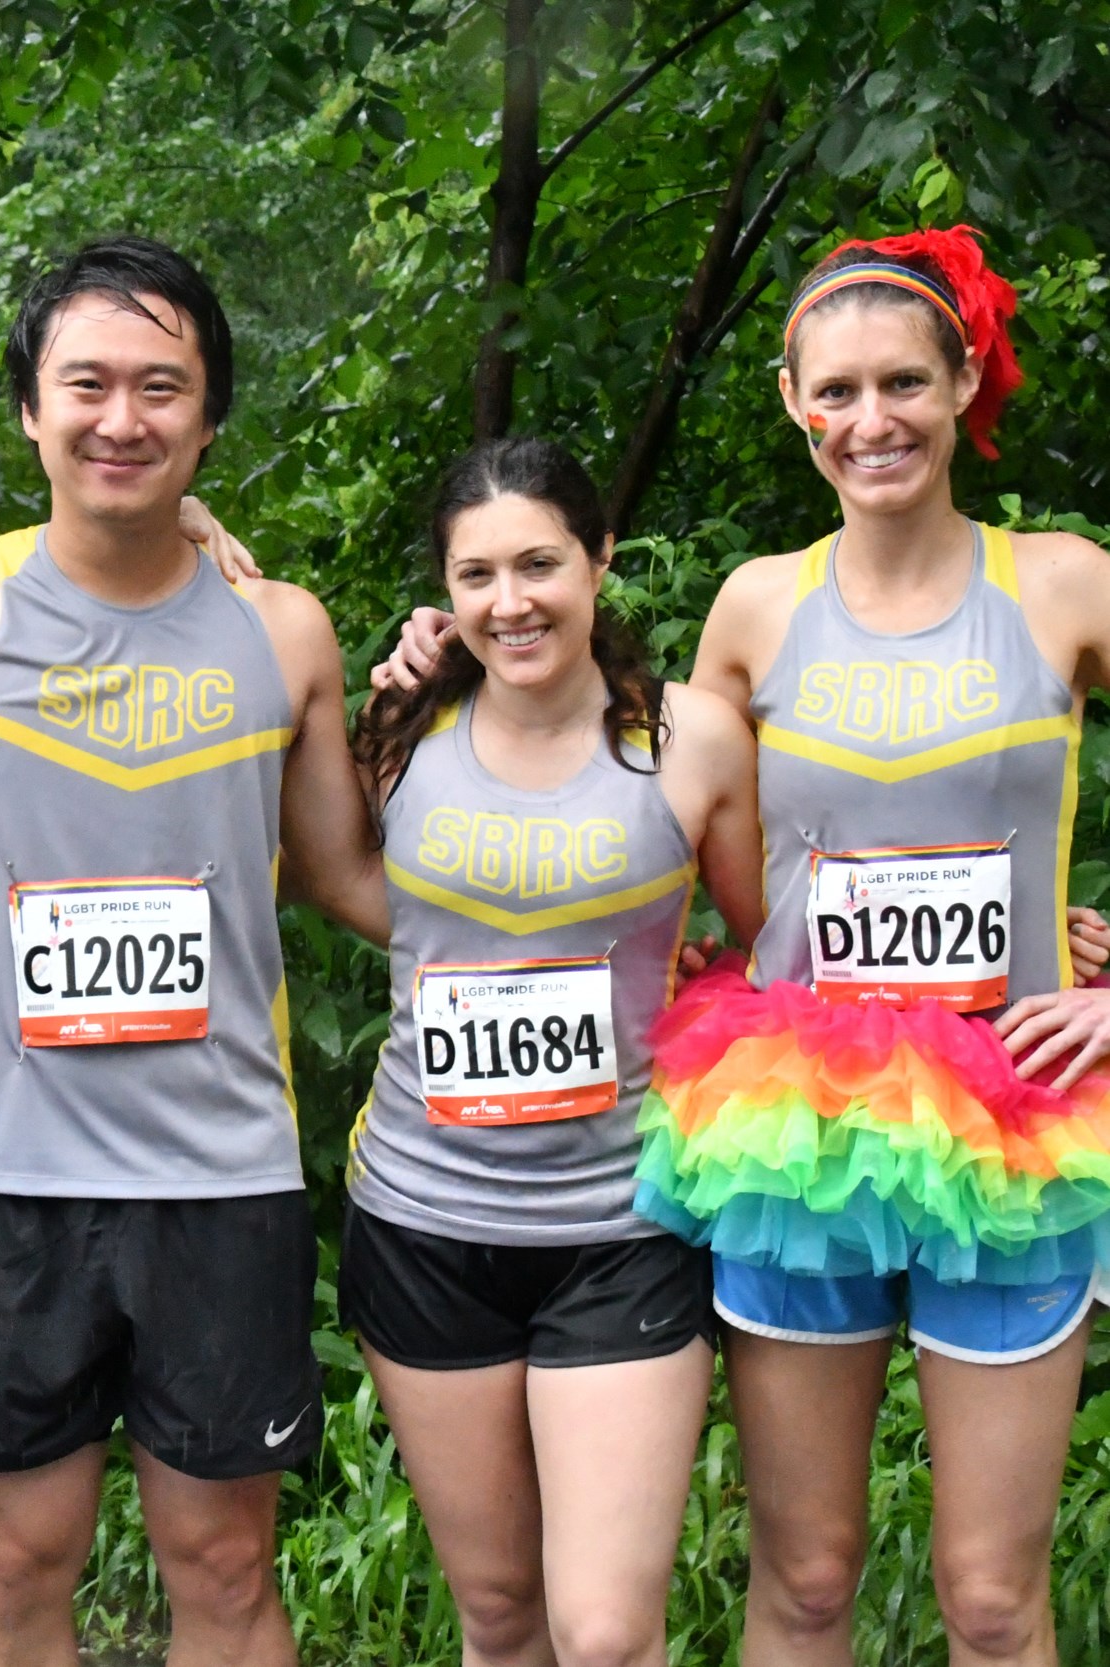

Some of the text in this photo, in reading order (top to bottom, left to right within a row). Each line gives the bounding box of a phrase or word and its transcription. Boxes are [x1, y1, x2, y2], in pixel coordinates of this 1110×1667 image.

[37, 664, 235, 752] SBRC
[793, 659, 1000, 745] SBRC
[417, 806, 628, 899] SBRC
[860, 868, 972, 883] LGBT PRIDE RUN
[63, 900, 172, 914] LGBT PRIDE RUN
[816, 900, 1006, 967] D12026
[23, 932, 205, 999] C12025
[461, 982, 569, 997] LGBT PRIDE RUN
[422, 1013, 605, 1080] D11684
